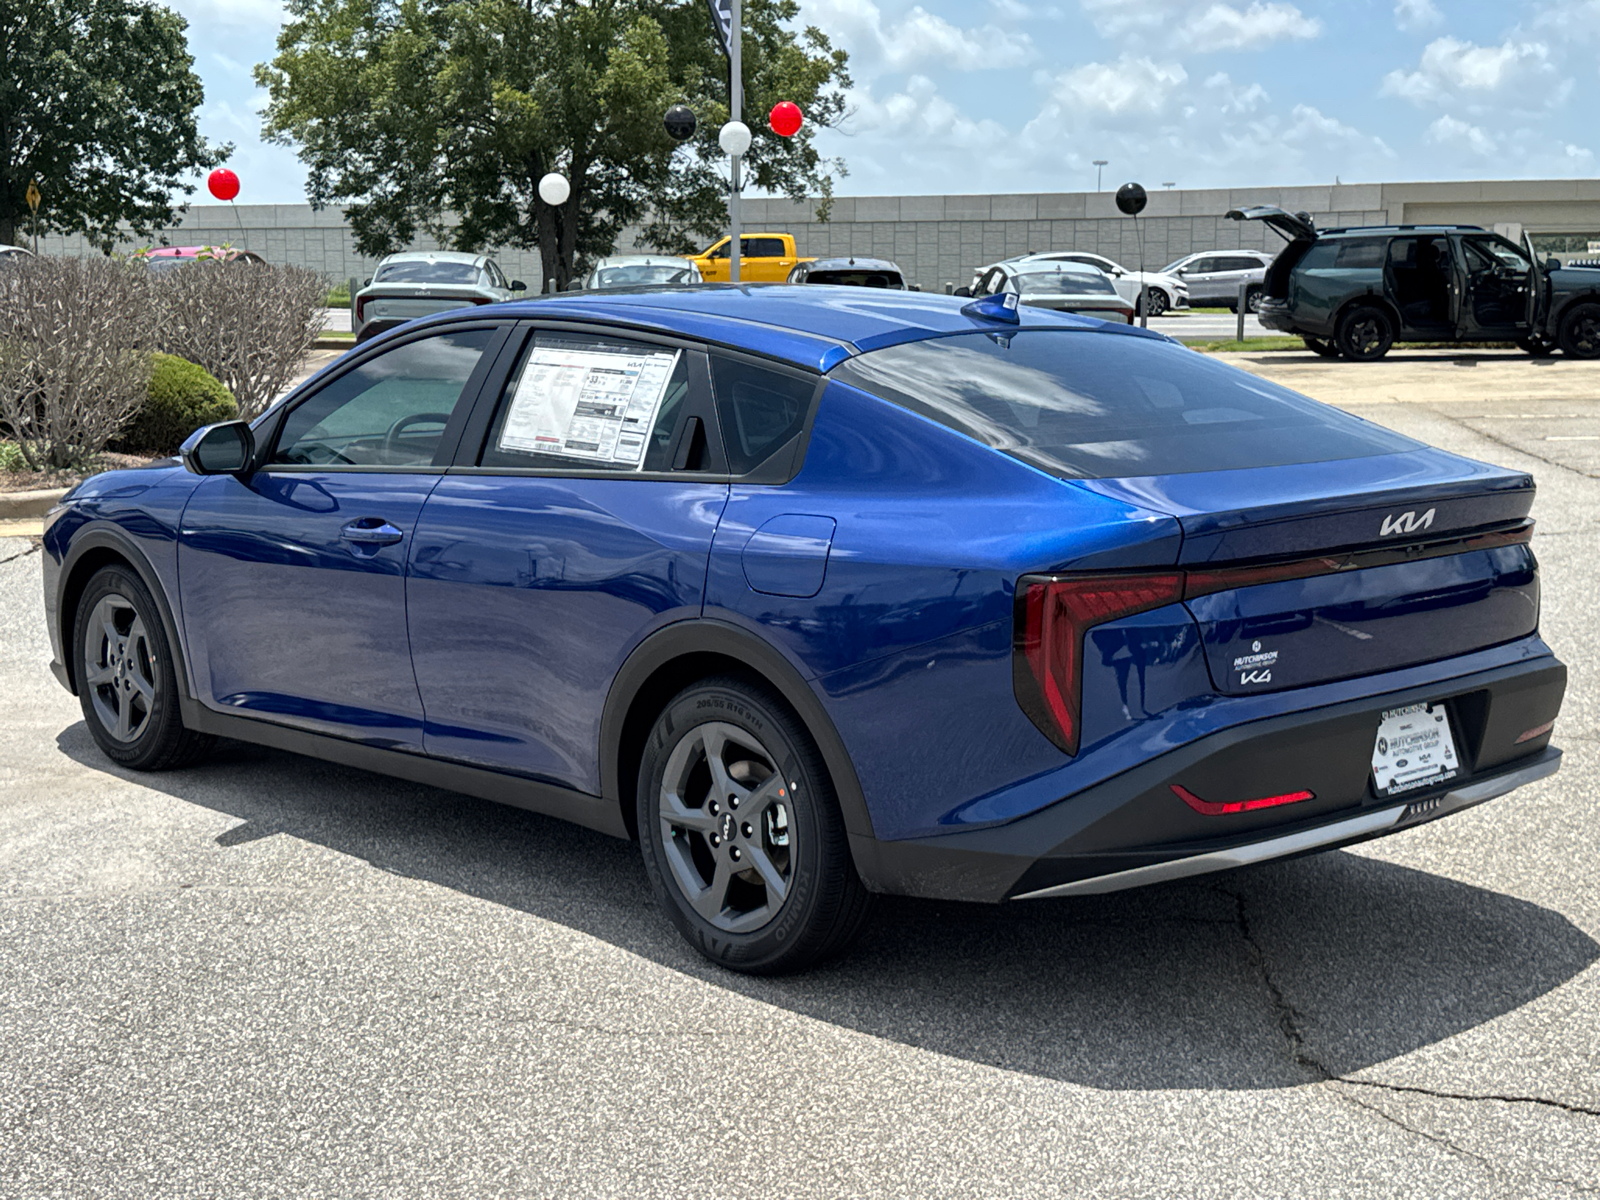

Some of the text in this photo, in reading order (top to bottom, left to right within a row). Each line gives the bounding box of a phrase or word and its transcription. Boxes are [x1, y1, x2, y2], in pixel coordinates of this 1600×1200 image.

[1380, 508, 1436, 536] KIA
[1233, 651, 1279, 667] HUTCHINSON
[1240, 669, 1272, 685] K4
[1390, 731, 1440, 749] HUTCHINSON
[1392, 739, 1440, 757] AUTOMOTIVE GROUP
[775, 870, 810, 941] KUMHO
